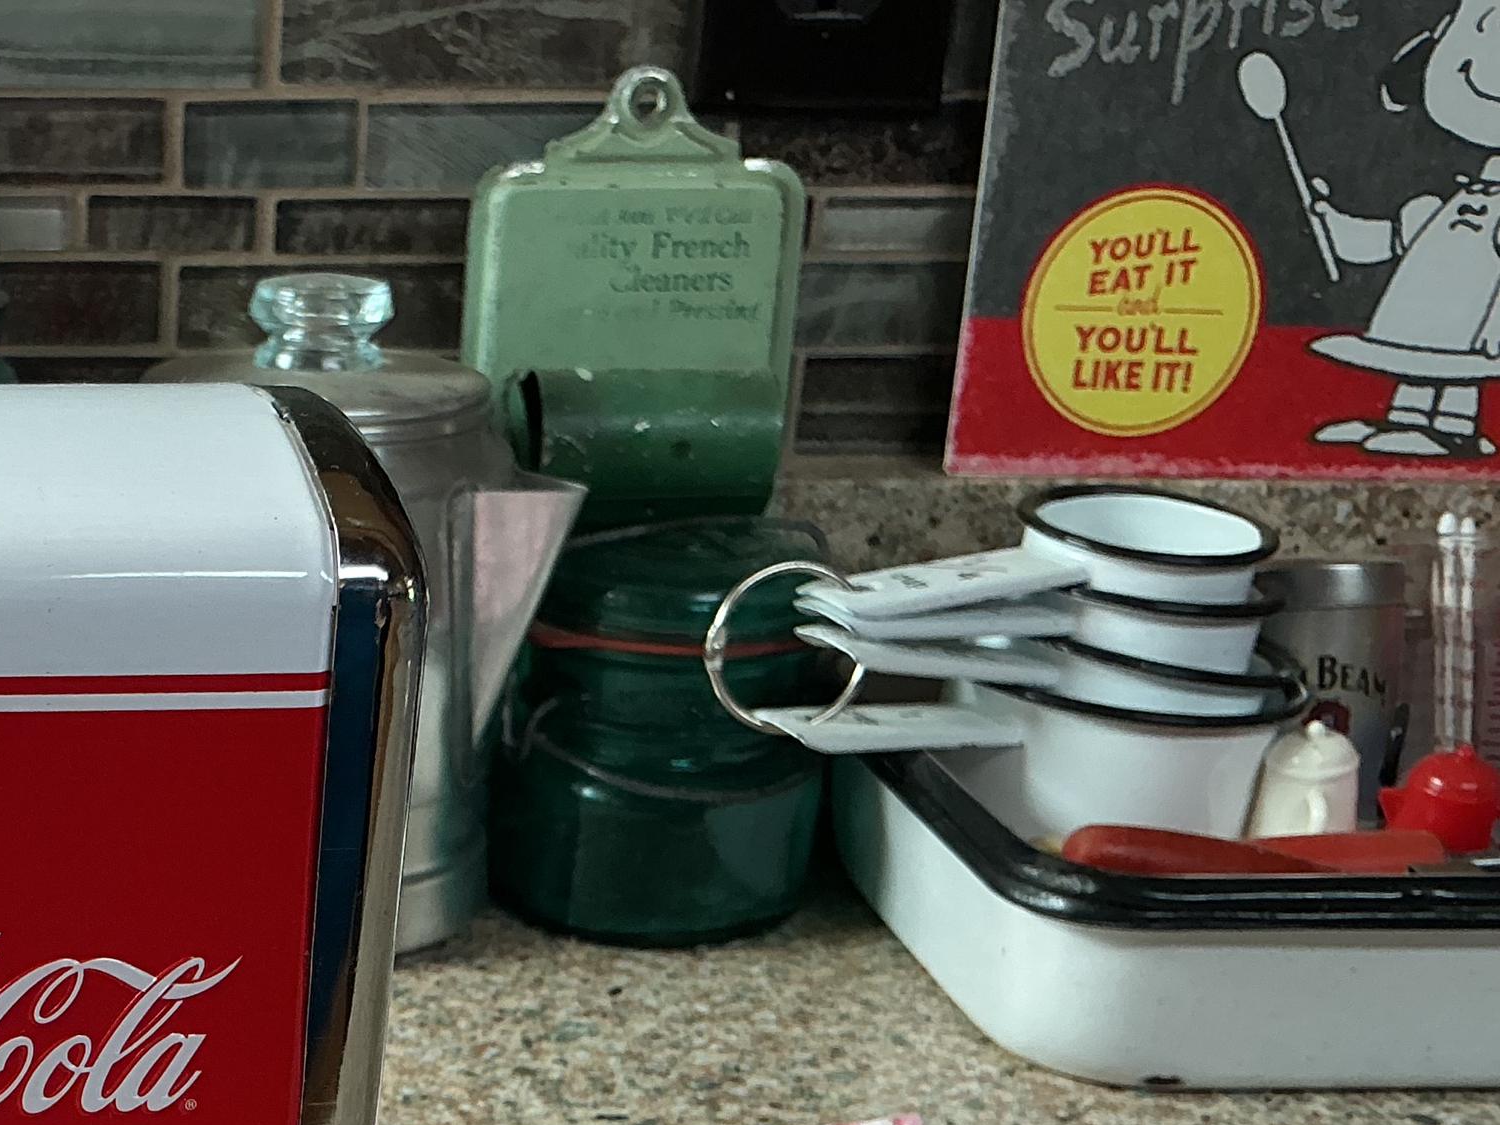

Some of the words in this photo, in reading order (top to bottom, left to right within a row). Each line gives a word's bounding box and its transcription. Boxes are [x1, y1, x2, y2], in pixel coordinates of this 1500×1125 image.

[1045, 0, 1359, 105] Surprise
[651, 230, 751, 259] French
[1089, 227, 1202, 264] YOU'LL
[609, 263, 734, 293] Cleaners
[1088, 264, 1153, 296] EAT
[1165, 257, 1197, 287] IT
[1076, 321, 1198, 356] YOU'LL
[1073, 359, 1144, 391] LIKE
[1151, 361, 1192, 393] IT!
